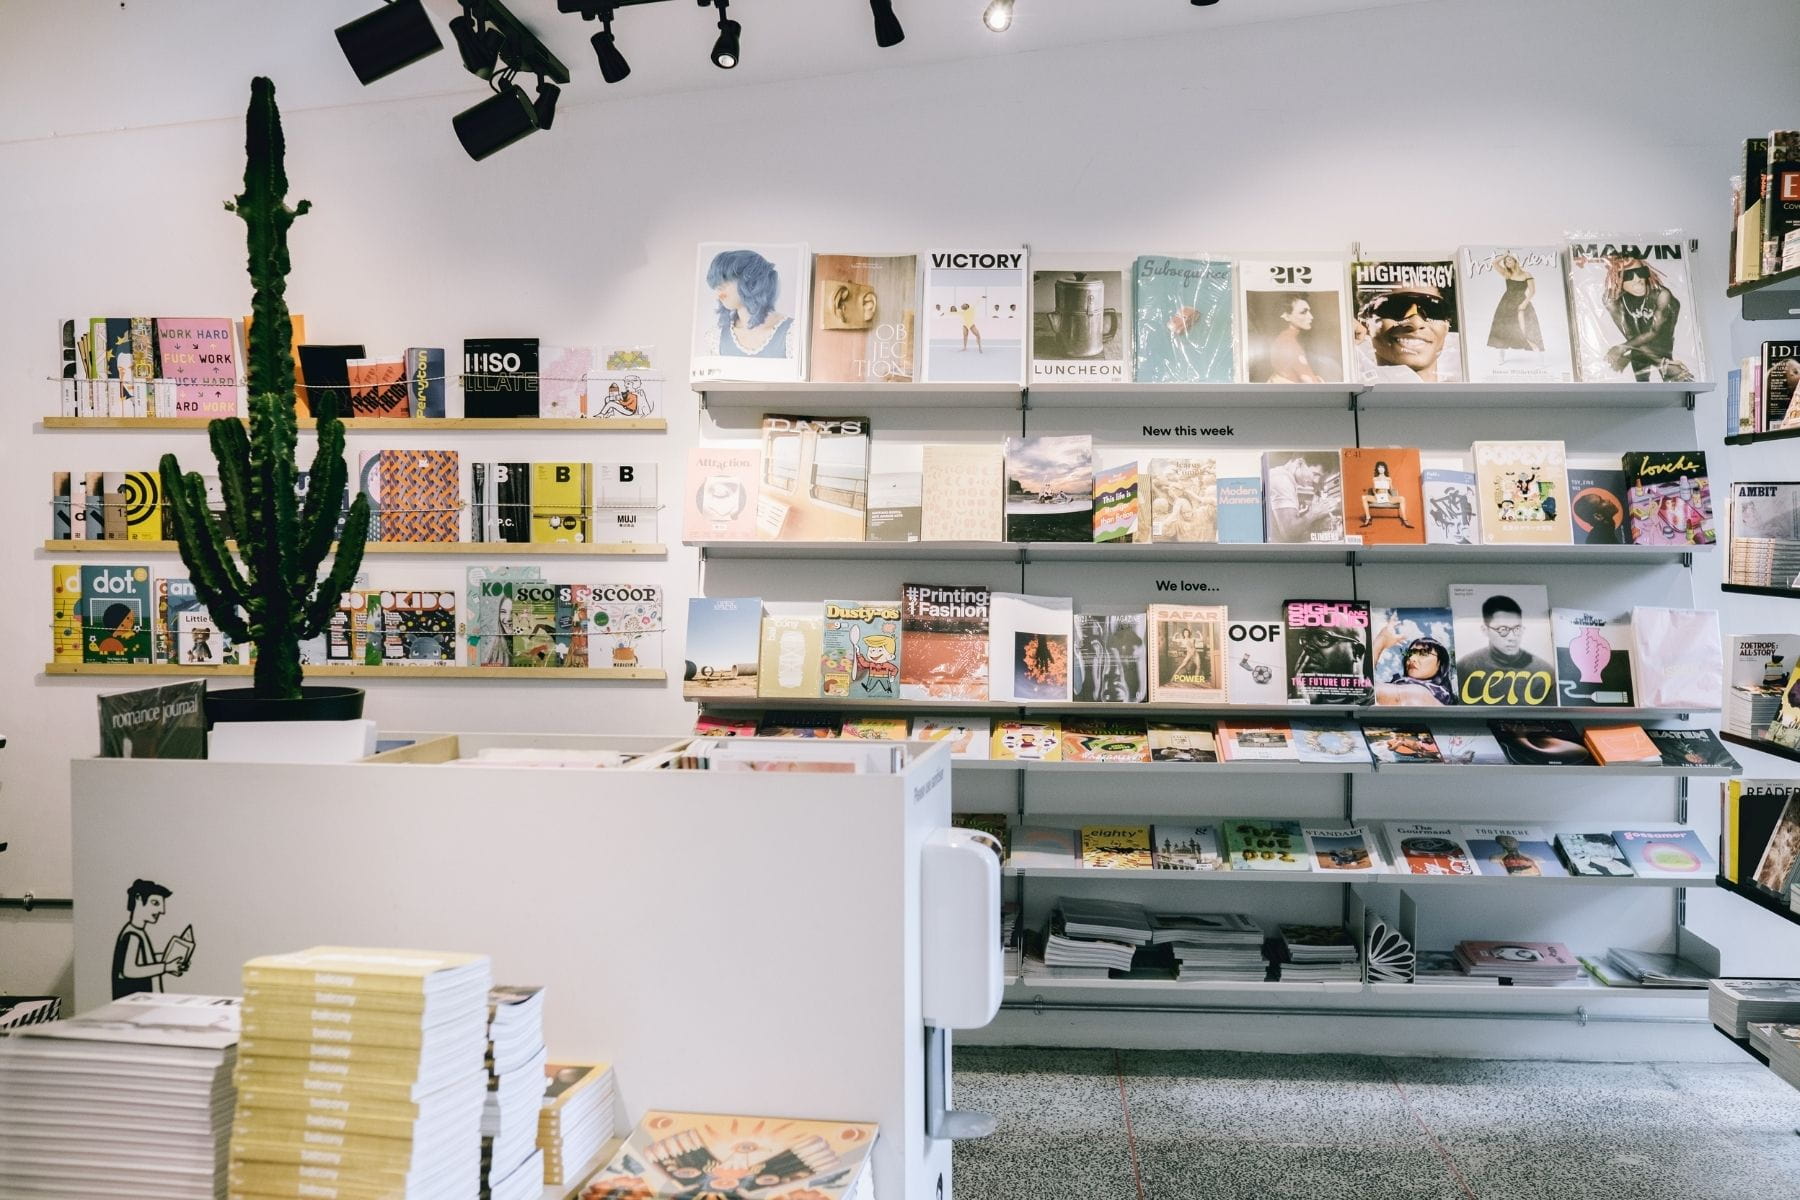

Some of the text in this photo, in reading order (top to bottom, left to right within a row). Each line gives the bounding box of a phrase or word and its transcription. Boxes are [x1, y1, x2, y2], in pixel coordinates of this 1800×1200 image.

[932, 253, 1022, 268] VICTORY
[1270, 266, 1313, 284] 212
[160, 329, 229, 339] WORK HARD
[875, 323, 908, 341] OB
[163, 353, 232, 364] FUCK WORK
[1034, 365, 1122, 375] LUNCHEON
[168, 377, 198, 387] UCK
[176, 401, 235, 412] ARD WORK
[766, 418, 862, 435] DAYS
[1142, 425, 1234, 436] New this week
[494, 466, 509, 482] B
[555, 466, 571, 482] B
[619, 466, 634, 482] B
[1220, 485, 1258, 496] Modern
[1739, 486, 1778, 497] AMBIT
[1103, 495, 1115, 504] This
[617, 514, 637, 523] MUJI
[92, 569, 137, 594] dot.
[1156, 580, 1220, 591] We love...
[592, 588, 656, 601] SCOOP
[906, 586, 988, 605] #Printing
[918, 601, 988, 618] Fashion
[1288, 602, 1352, 615] SIGHT
[185, 615, 208, 623] Little
[1157, 610, 1219, 620] SAFAR
[1288, 614, 1369, 628] SOUND
[1228, 624, 1280, 642] OOF
[1174, 674, 1206, 684] POWER
[1291, 677, 1307, 686] THE
[1309, 677, 1339, 687] FUTURE
[1341, 678, 1350, 687] OF
[1462, 669, 1552, 706] cero
[112, 693, 198, 729] romance journal
[1623, 831, 1687, 840] gossamer
